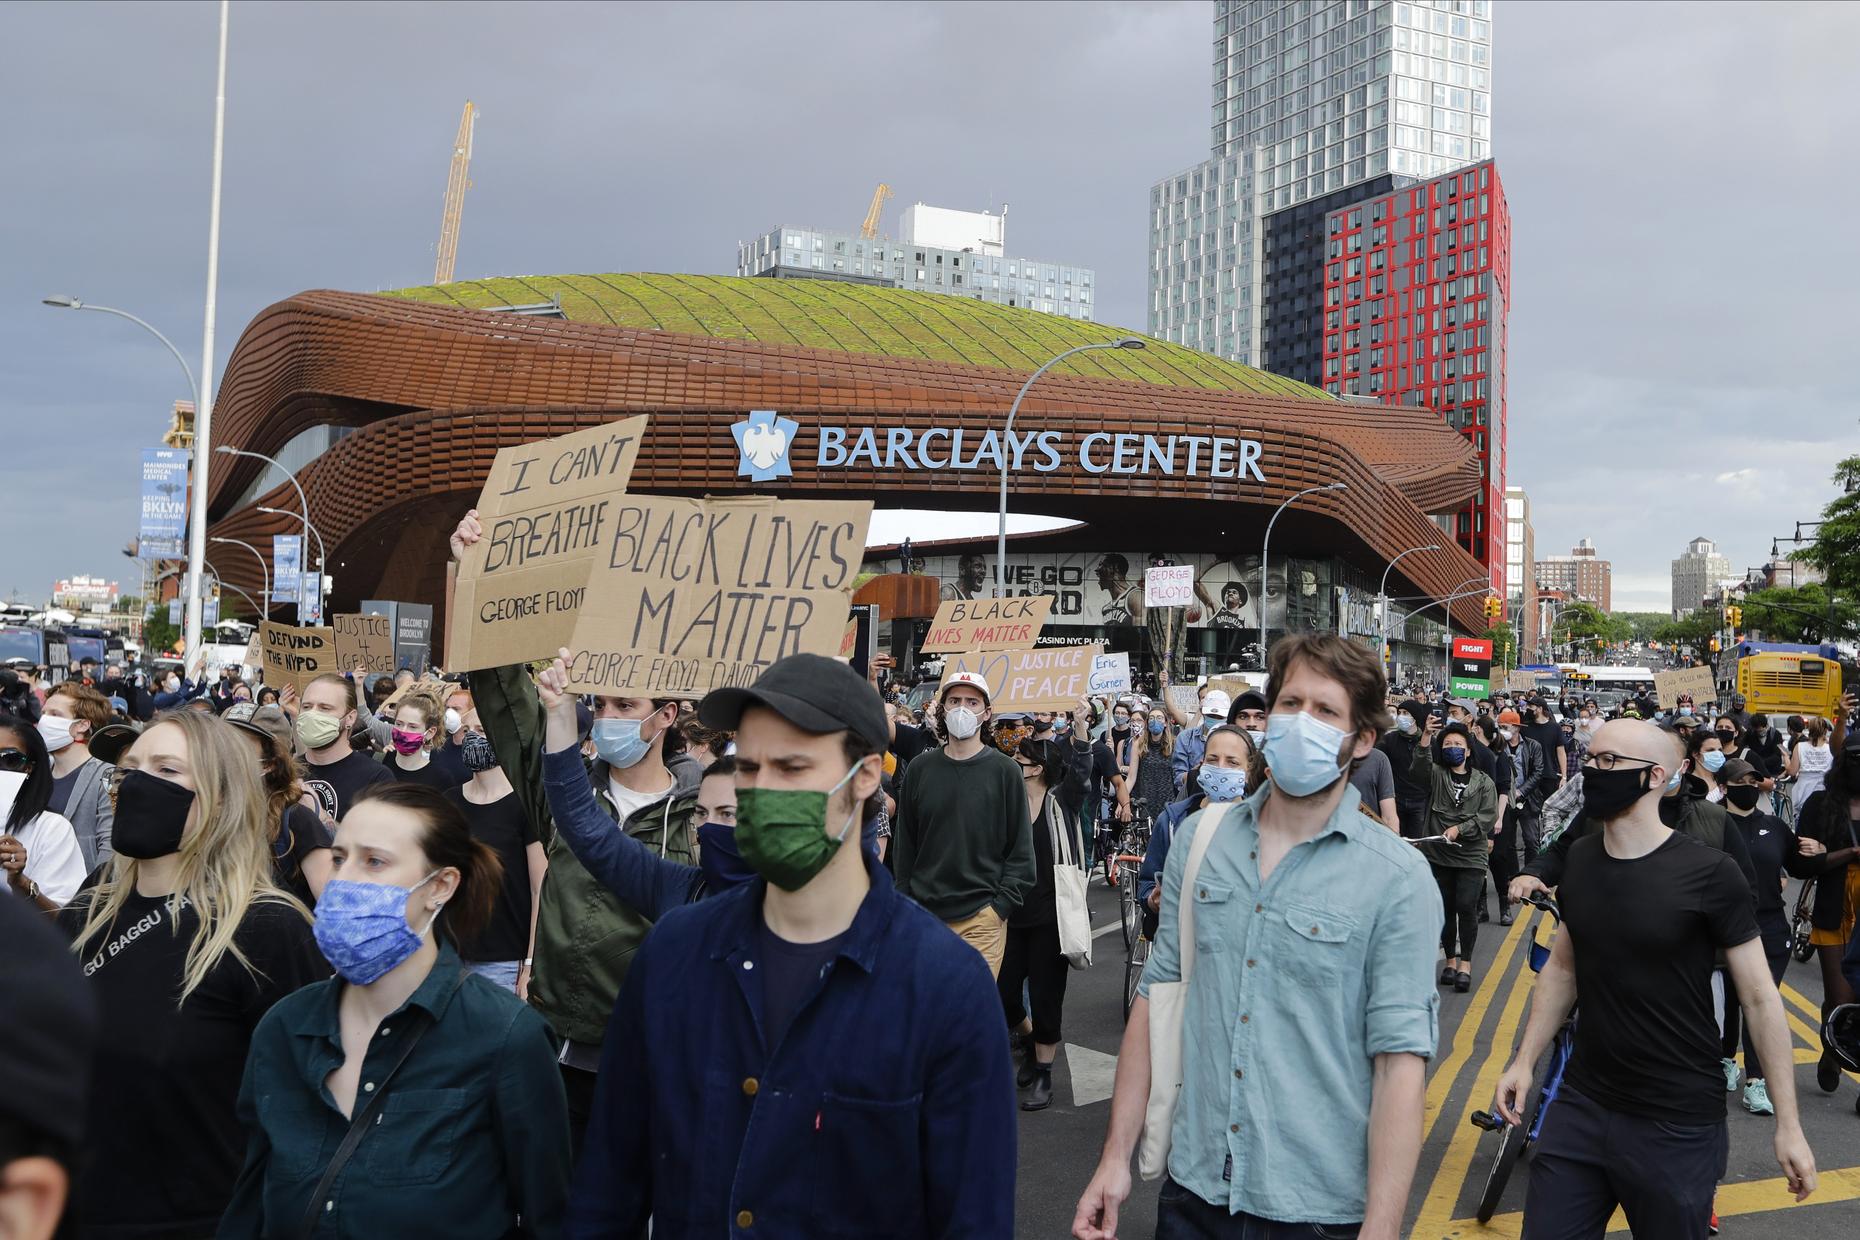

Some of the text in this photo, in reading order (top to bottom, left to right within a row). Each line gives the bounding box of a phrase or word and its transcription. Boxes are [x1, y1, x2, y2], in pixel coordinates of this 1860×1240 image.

[815, 427, 1267, 482] BARCLAYS CENTER
[143, 462, 186, 470] MAIMONIDES
[499, 434, 634, 496] I CAN'T
[142, 502, 185, 513] BKLYN
[150, 512, 162, 520] THE
[484, 501, 609, 573] BREATHE
[609, 507, 853, 591] BLACK LIVES
[992, 565, 1083, 586] WE GO
[1149, 569, 1189, 581] GEORGE
[1150, 586, 1192, 598] FLOYD
[480, 593, 541, 623] GEORGE
[950, 599, 1037, 623] BLACK
[335, 615, 390, 637] JUSTICE
[399, 628, 424, 639] BROOKLYN
[400, 618, 429, 629] WELCOME TO
[631, 587, 813, 666] MATTER
[268, 629, 324, 649] DEFUND
[925, 624, 1032, 646] LIVES MATTER
[1037, 636, 1110, 646] CASINO NYC PLAZA
[359, 639, 370, 655] 4
[1461, 644, 1484, 653] FIGHT
[266, 649, 318, 671] THE NYPD
[342, 652, 394, 672] GEORGE
[1013, 649, 1084, 671] JUSTICE
[1096, 655, 1118, 669] Eric
[1463, 663, 1479, 672] THE
[569, 650, 643, 688] GEORGE
[646, 657, 700, 692] FLOYD
[1089, 672, 1124, 690] Garner
[1010, 673, 1082, 700] PEACE
[1455, 682, 1484, 692] POWER
[83, 895, 193, 977] GU BAGGU BA
